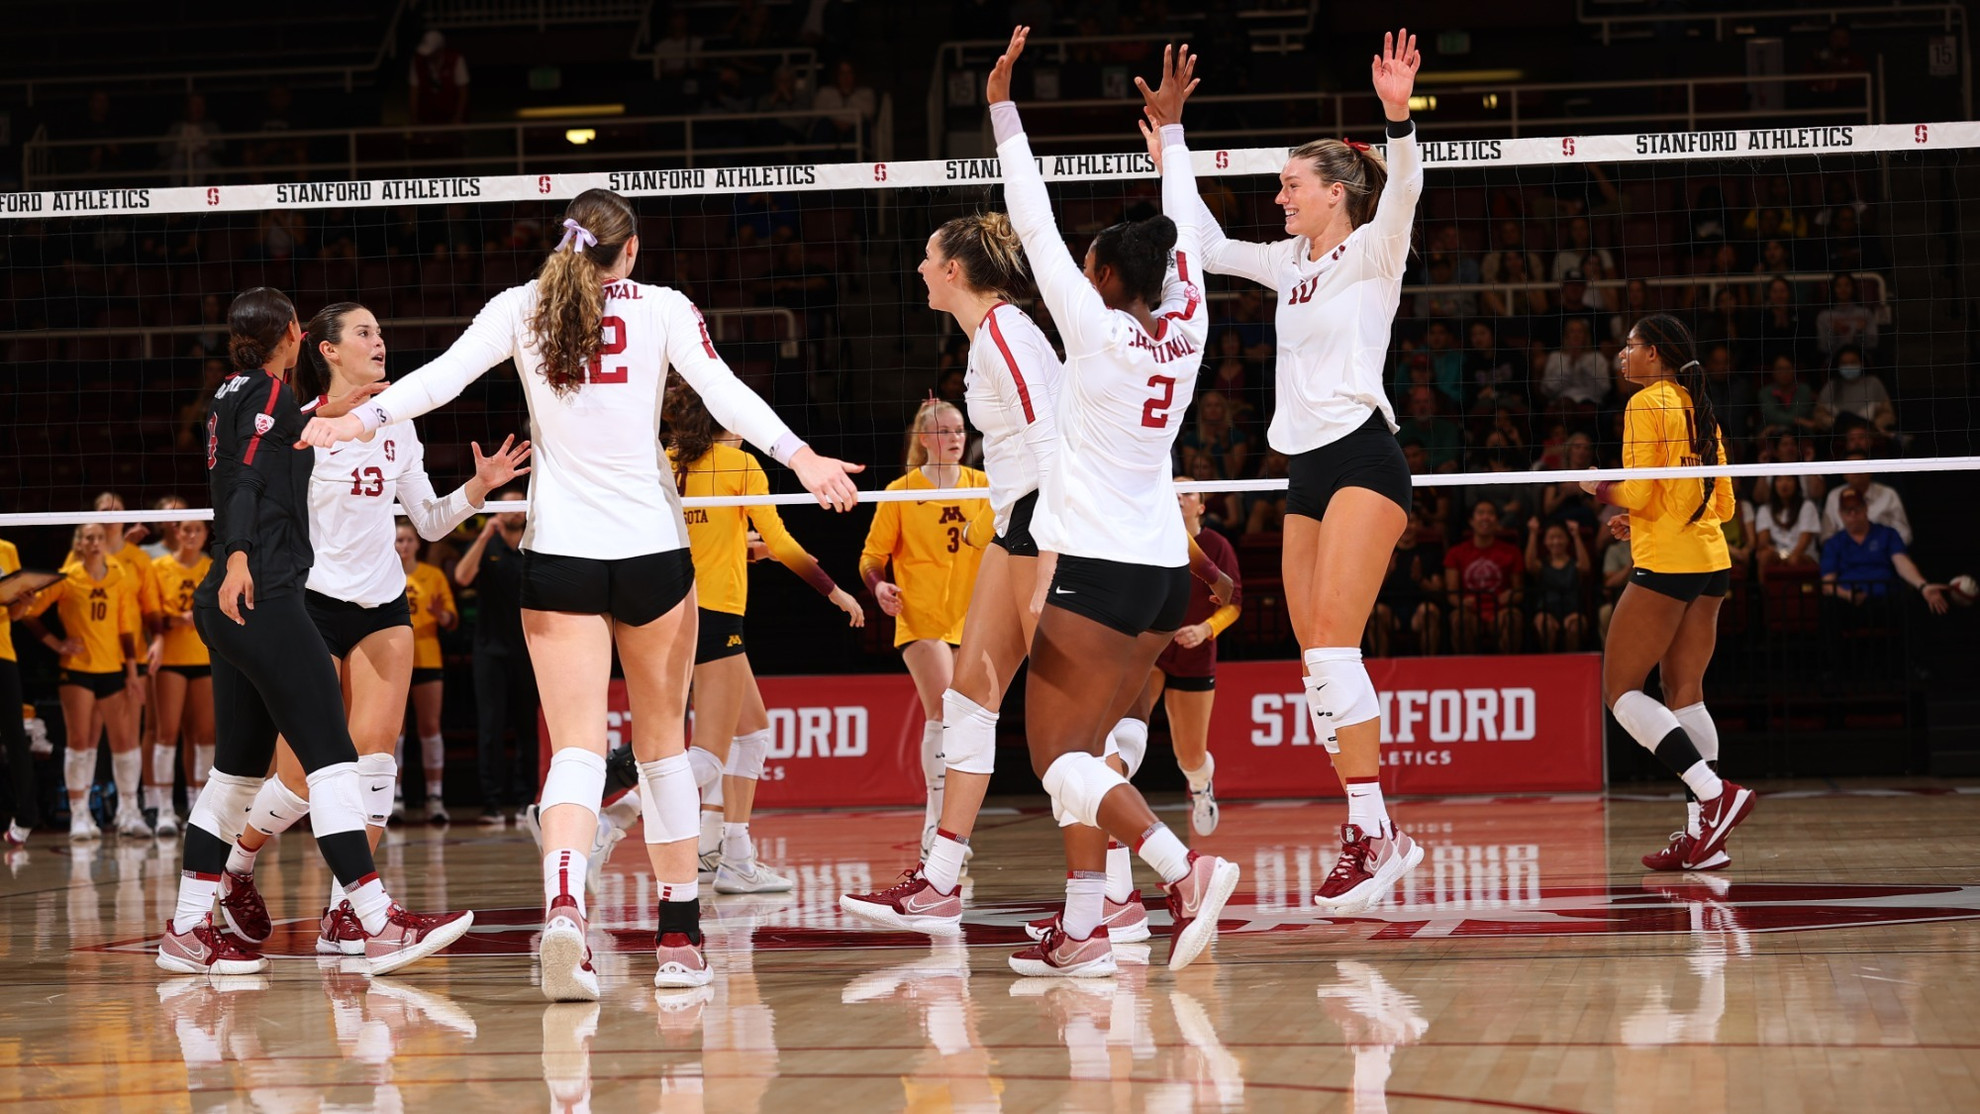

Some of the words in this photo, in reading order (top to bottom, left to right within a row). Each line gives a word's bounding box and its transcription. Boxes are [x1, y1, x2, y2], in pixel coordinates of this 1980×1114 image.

[1636, 131, 1737, 155] STANFORD
[1748, 127, 1853, 150] ATHLETICS
[1914, 125, 1927, 144] S
[1416, 140, 1501, 162] HLETICS
[1562, 138, 1575, 156] S
[946, 154, 1043, 180] STAND
[1054, 153, 1156, 176] ATHLETICS
[1216, 151, 1228, 169] S
[609, 170, 705, 191] STANFORD
[715, 165, 815, 187] ATHLETICS
[873, 164, 887, 182] S
[277, 182, 371, 203] STANFORD
[382, 178, 481, 200] ATHLETICS
[538, 176, 551, 194] S
[53, 190, 150, 211] ATHLETICS
[207, 188, 219, 206] S
[555, 316, 628, 384] 2
[1141, 374, 1176, 428] 2
[351, 466, 384, 497] 13
[938, 506, 966, 524] M
[947, 527, 959, 553] 3
[91, 602, 106, 621] 10
[726, 635, 742, 647] M
[1251, 688, 1535, 746] STFORD
